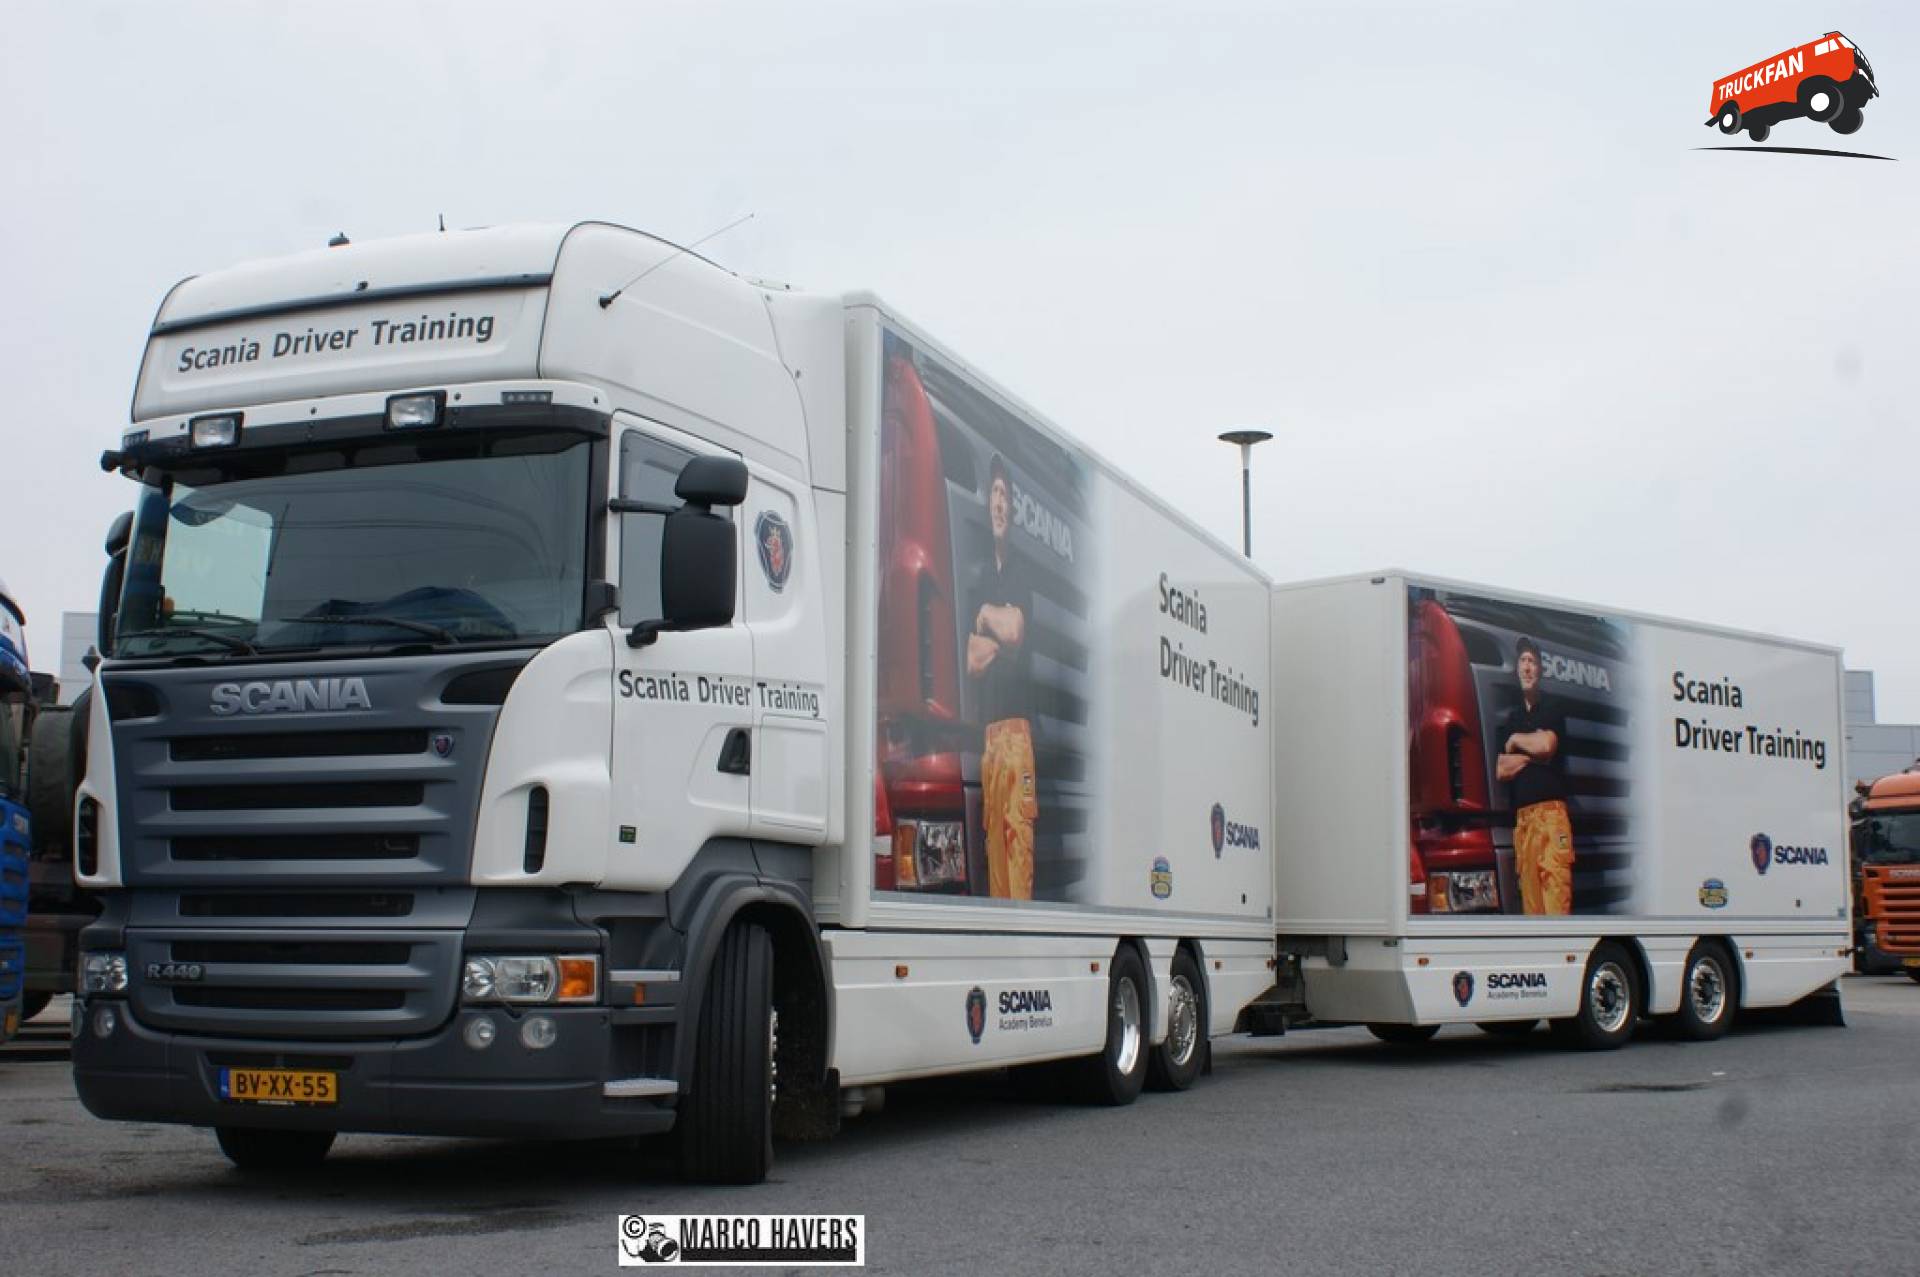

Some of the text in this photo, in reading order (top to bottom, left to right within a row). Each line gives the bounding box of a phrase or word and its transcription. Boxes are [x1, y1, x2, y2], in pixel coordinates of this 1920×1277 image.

[178, 313, 494, 373] Scania Driver Training
[1012, 482, 1074, 563] SCANIA
[1159, 572, 1207, 634] Scania
[1160, 635, 1258, 727] Driver Training
[1541, 651, 1611, 692] SCANIA
[1673, 671, 1742, 708] Scania
[209, 677, 373, 715] SCANIA
[619, 669, 819, 718] Scania Driver Training
[1675, 717, 1825, 769] Driver Training
[1226, 821, 1260, 850] SCANIA
[1774, 845, 1828, 865] SCANIA
[1486, 973, 1547, 988] SCANIA
[999, 990, 1052, 1013] SCANIA
[235, 1073, 330, 1098] BV-XX-55
